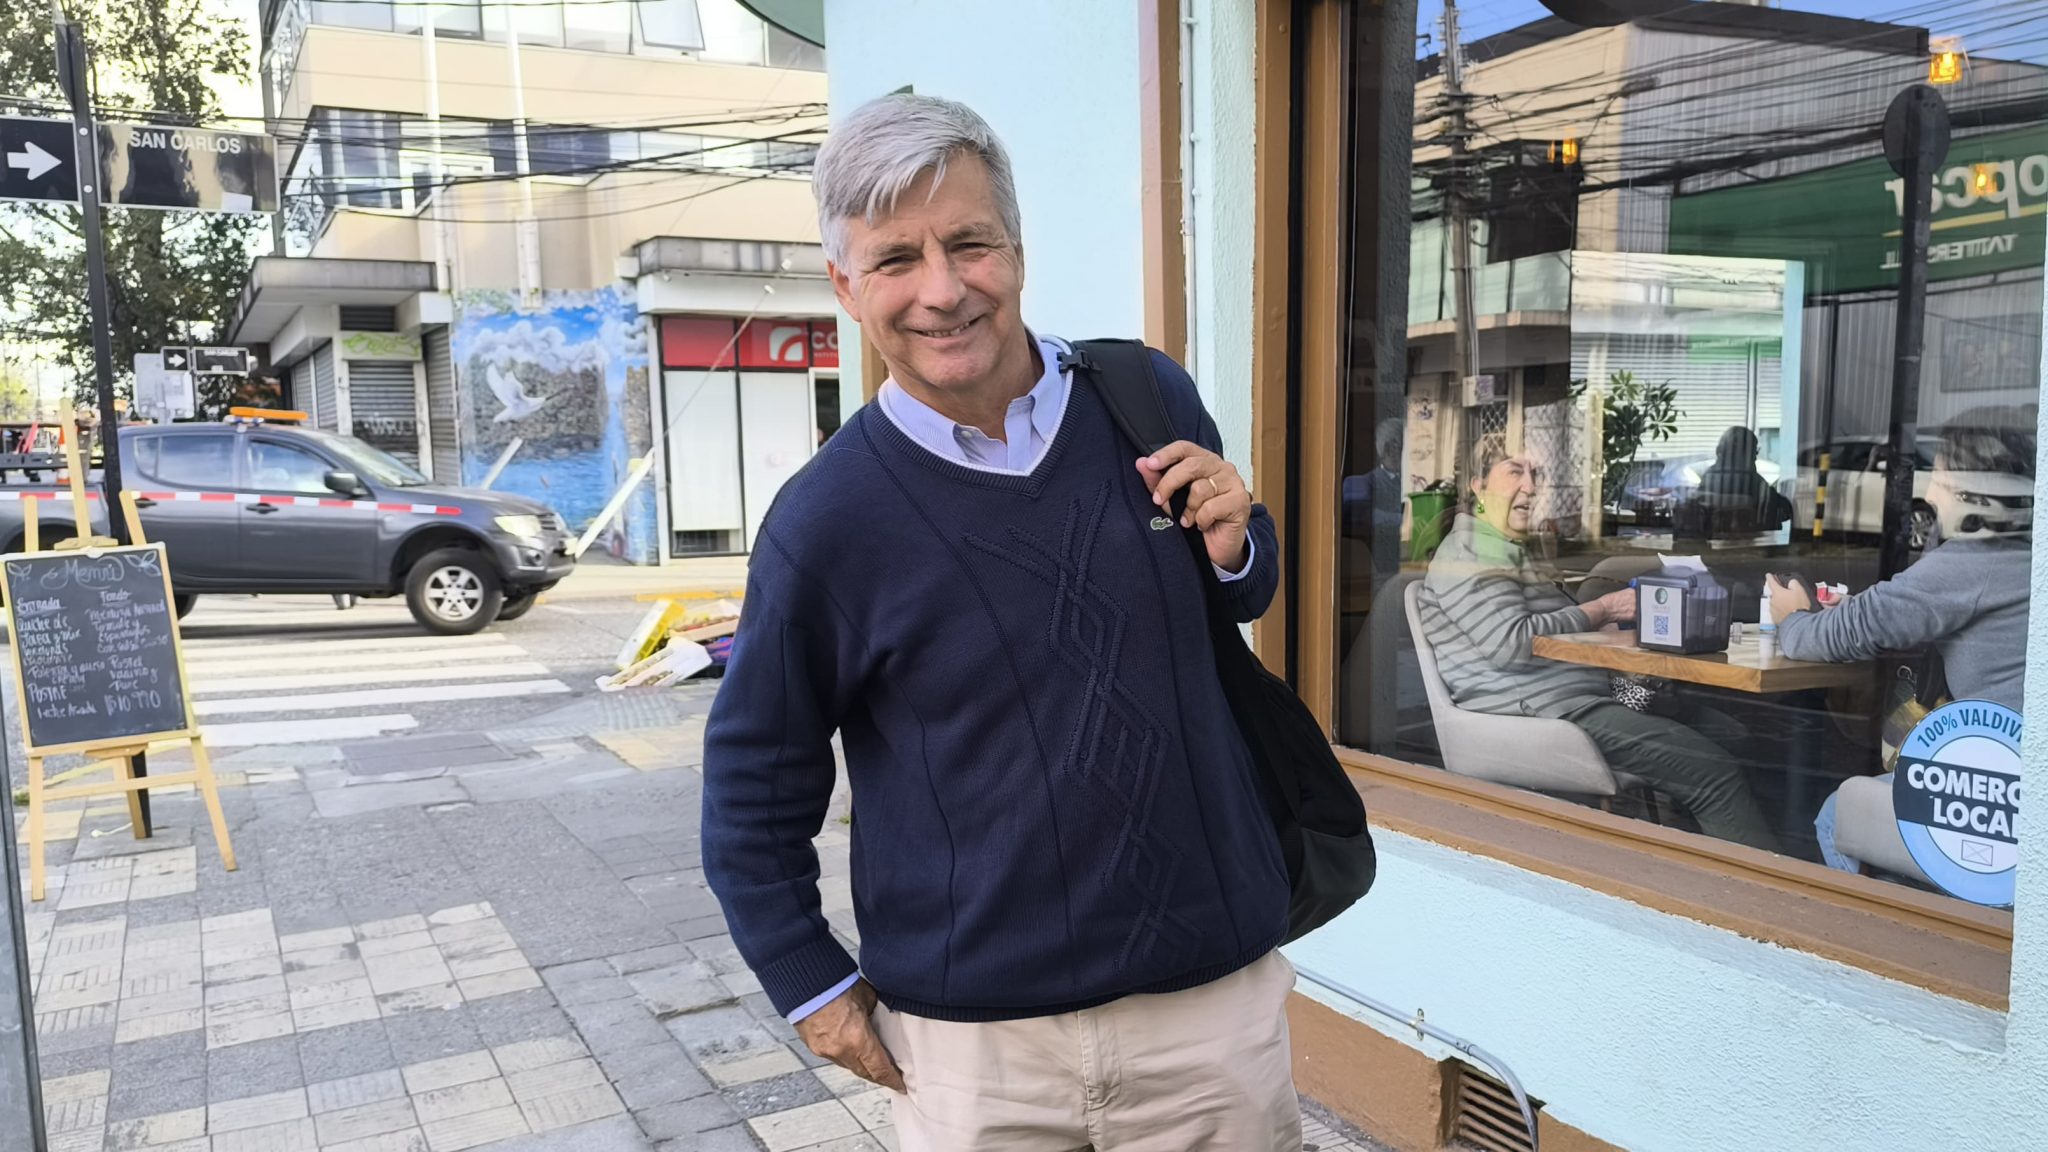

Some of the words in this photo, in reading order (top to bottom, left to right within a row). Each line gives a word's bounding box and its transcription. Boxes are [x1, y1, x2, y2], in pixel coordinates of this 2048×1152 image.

[130, 130, 166, 150] SAN
[170, 133, 241, 155] CARLOS
[1917, 712, 1958, 748] 100%
